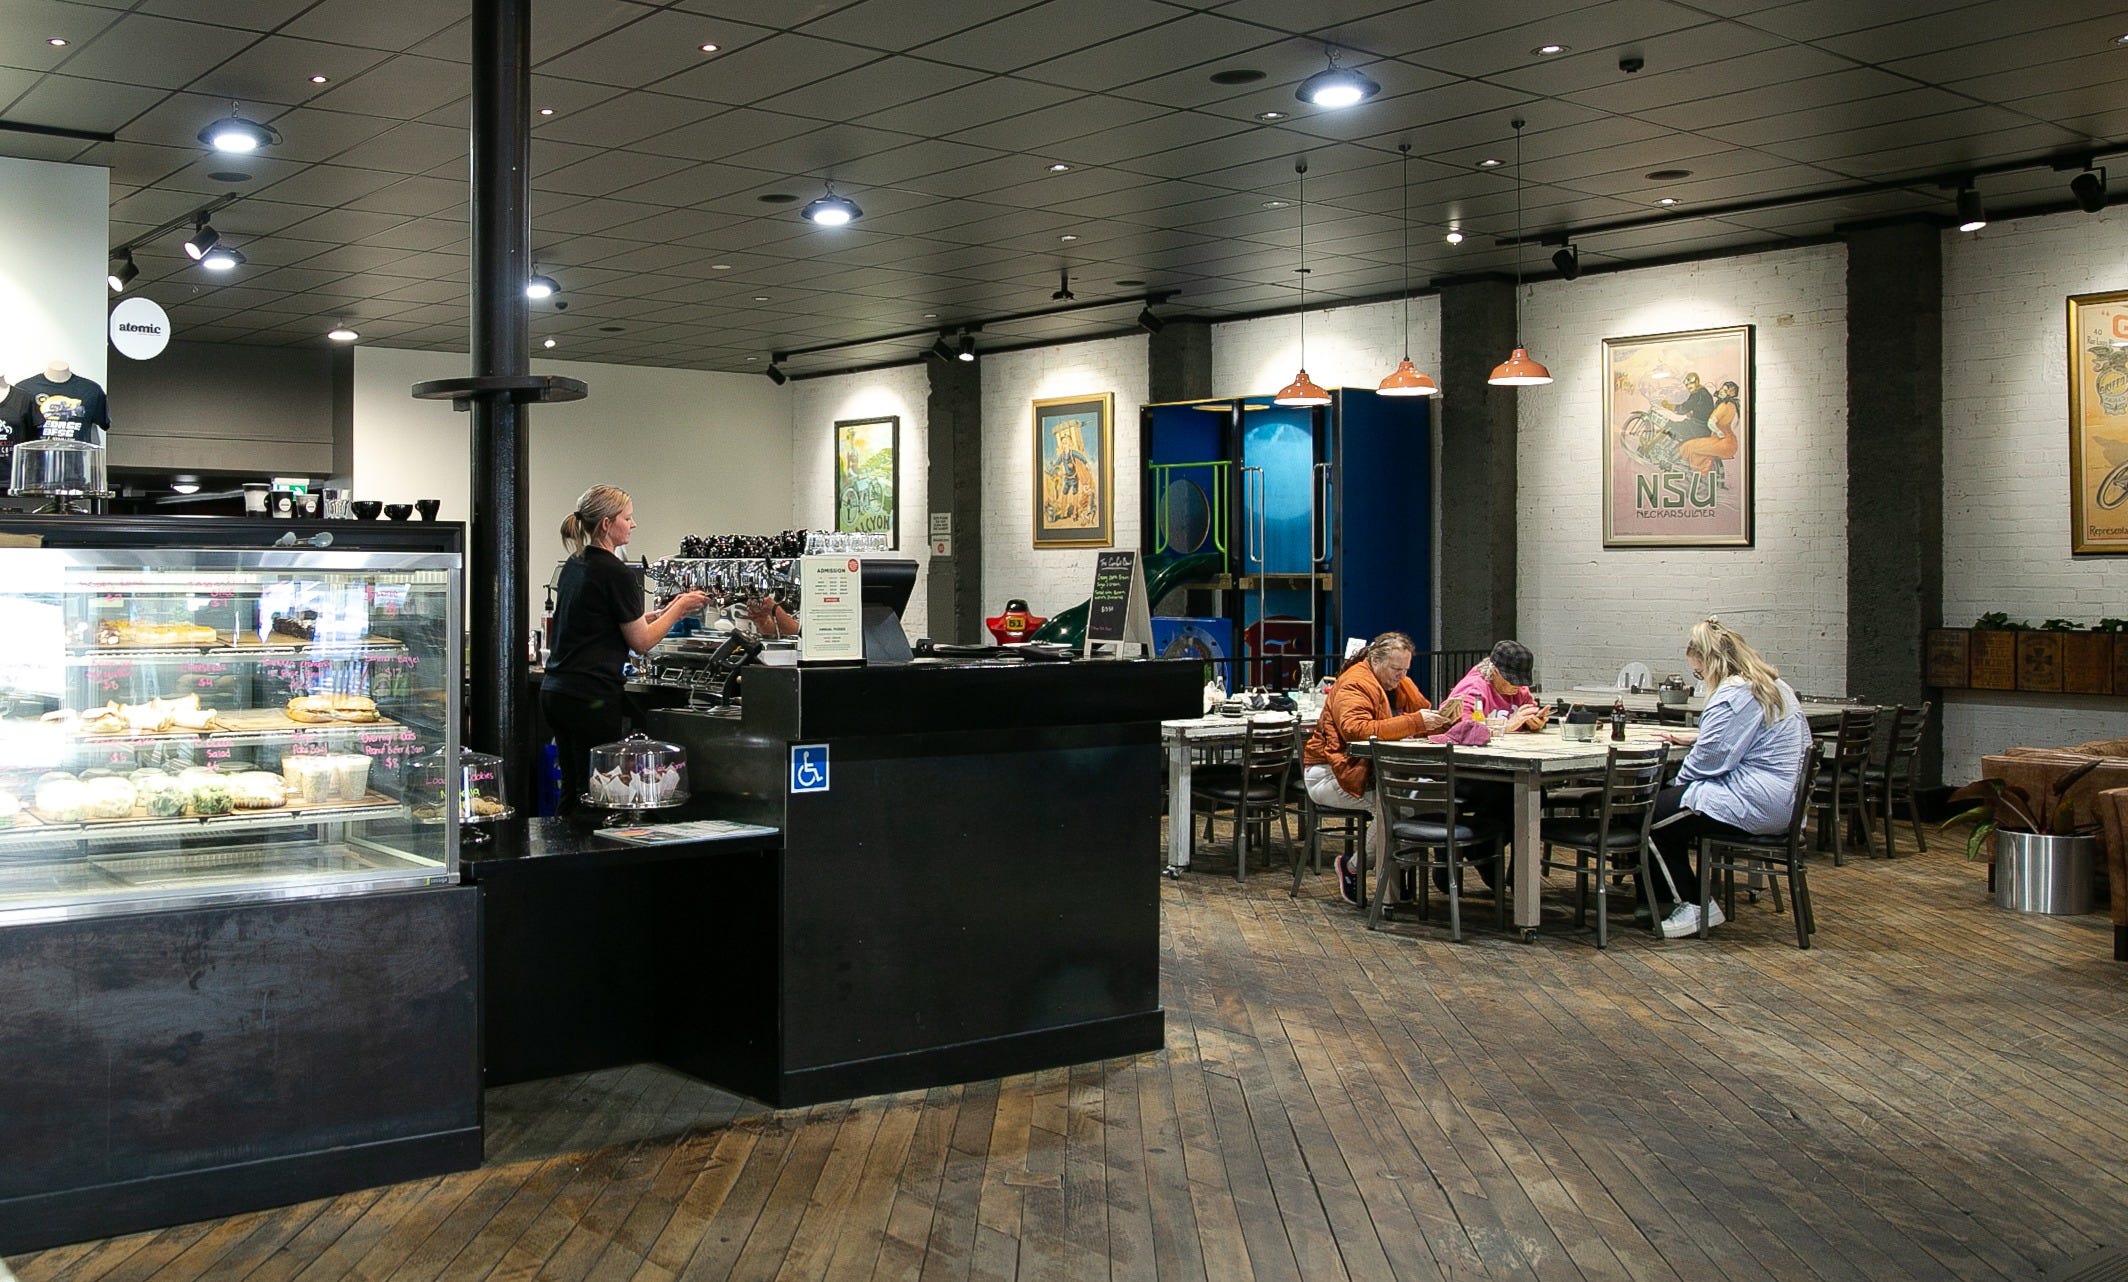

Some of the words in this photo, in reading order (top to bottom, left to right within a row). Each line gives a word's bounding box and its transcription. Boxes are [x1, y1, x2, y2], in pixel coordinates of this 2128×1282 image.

[119, 322, 162, 334] atomic
[1636, 472, 1716, 509] NSU
[1009, 619, 1023, 628] 51
[397, 653, 421, 668] Bagel
[206, 748, 232, 759] Salad
[384, 756, 400, 770] $8
